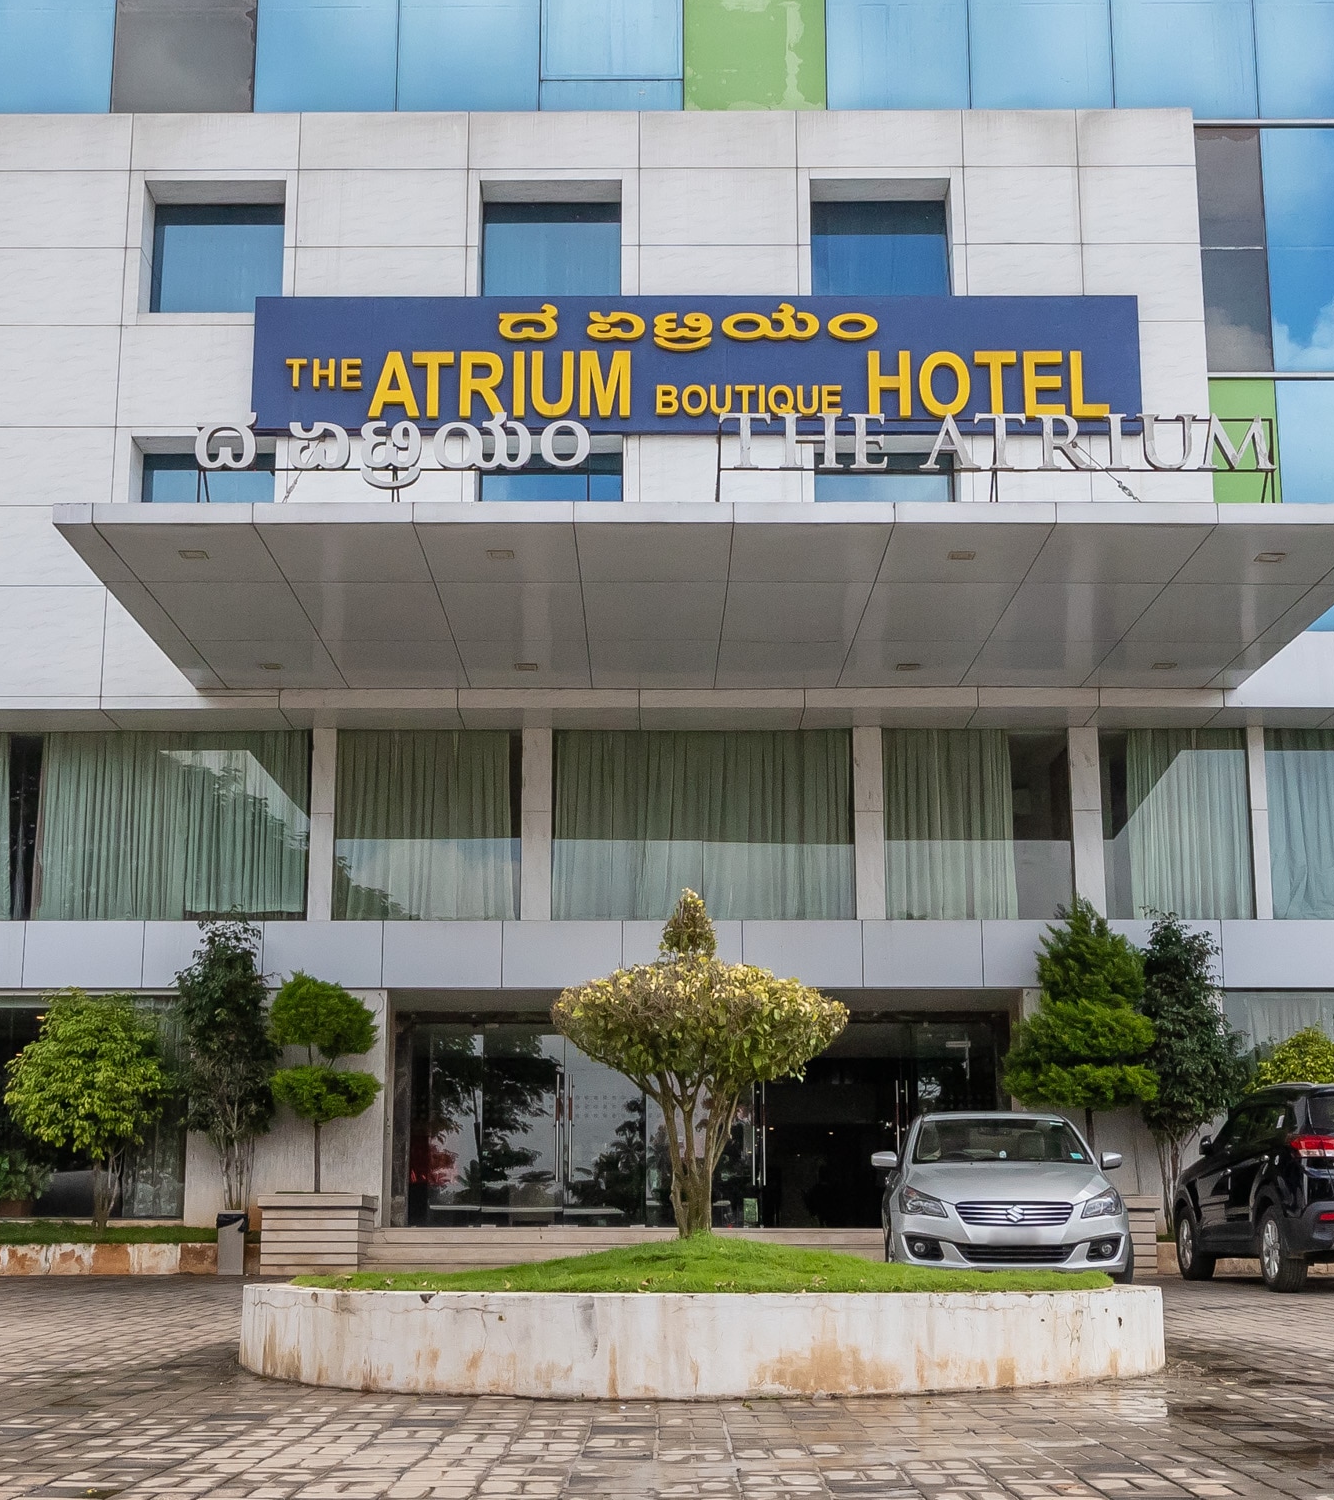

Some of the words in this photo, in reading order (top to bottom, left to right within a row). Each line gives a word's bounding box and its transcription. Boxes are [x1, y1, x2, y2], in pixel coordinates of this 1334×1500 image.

[498, 303, 559, 341] ದ
[586, 303, 879, 353] ಏಟ್ರಿಯಂ
[285, 358, 363, 390] THE
[367, 350, 632, 420] ATRIUM
[655, 384, 843, 416] BOUTIQUE
[867, 350, 1110, 419] HOTEL
[195, 412, 257, 469] ದ
[289, 412, 591, 489] ಏಟ್ರಿಯಂ
[719, 413, 889, 469] THE
[918, 412, 1277, 471] ATRIUM
